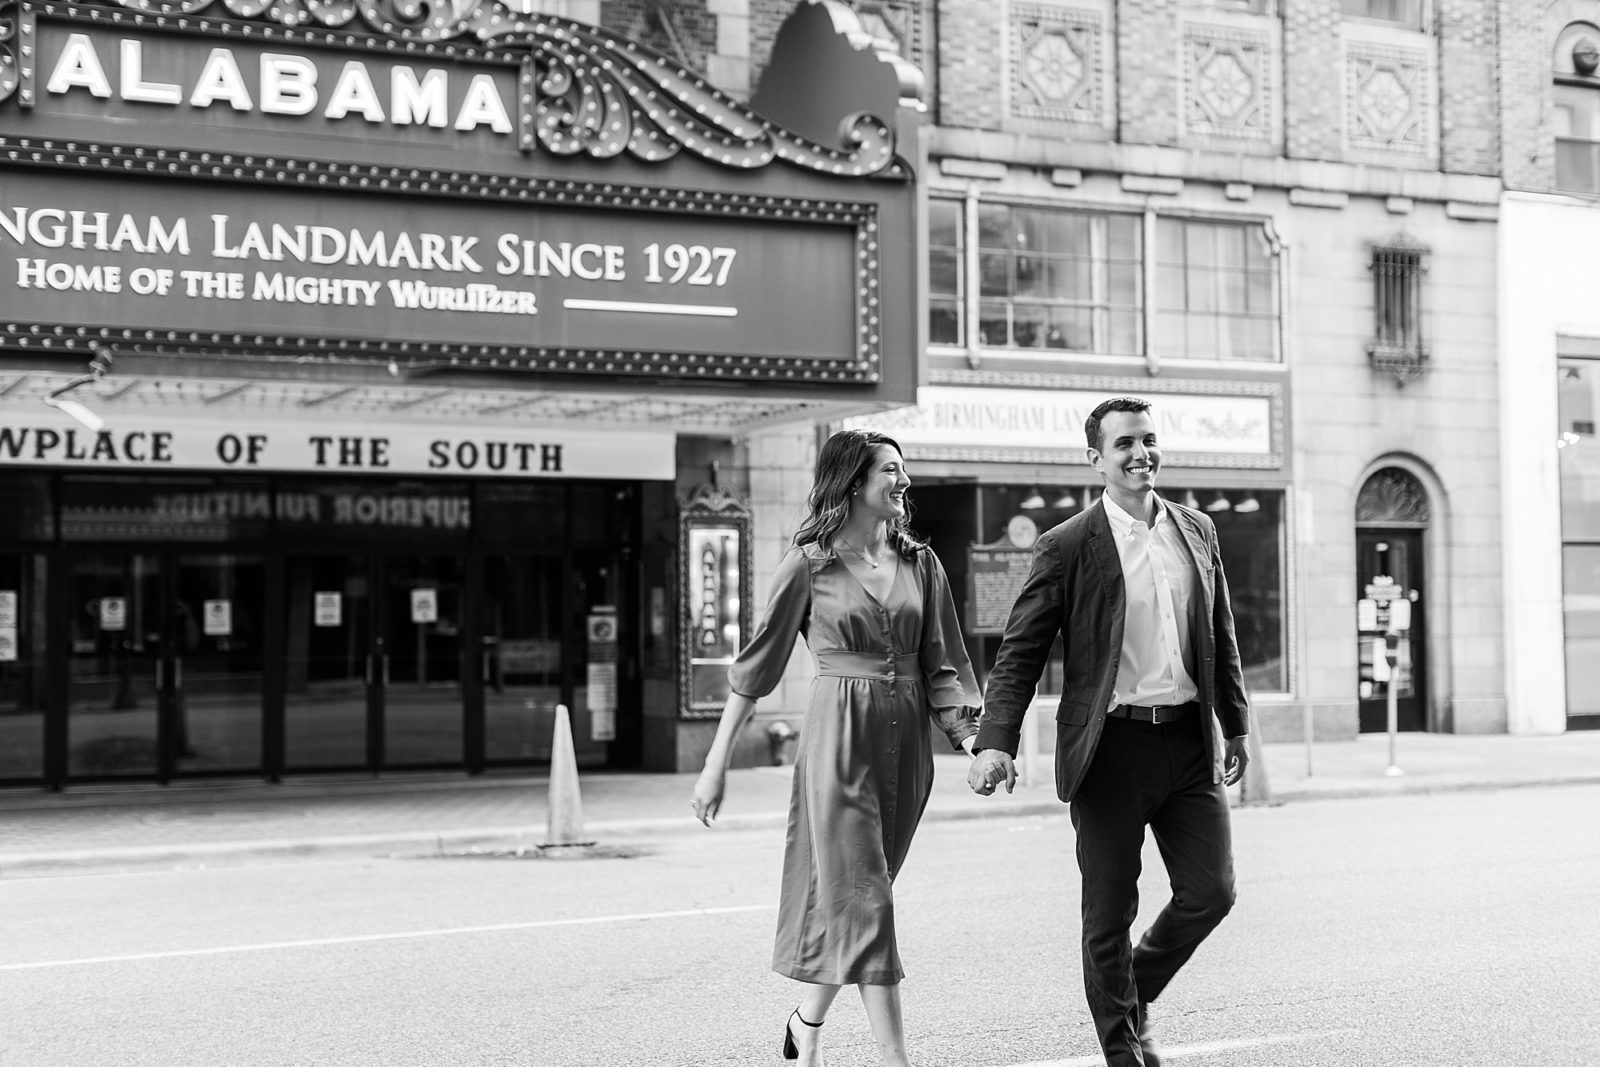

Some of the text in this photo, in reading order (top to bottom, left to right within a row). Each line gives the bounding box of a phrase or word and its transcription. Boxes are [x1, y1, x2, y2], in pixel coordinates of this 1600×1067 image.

[46, 33, 513, 134] ALABAMA
[211, 214, 483, 273] LANDMARK
[496, 233, 626, 280] SINCE
[643, 243, 737, 286] 1927
[16, 258, 538, 314] HOME OF THE MIGHTY WURLITZER
[933, 402, 1046, 432] BIRMINGHAM
[216, 434, 267, 464] OF
[309, 437, 390, 467] THE
[428, 440, 563, 471] SOUTH
